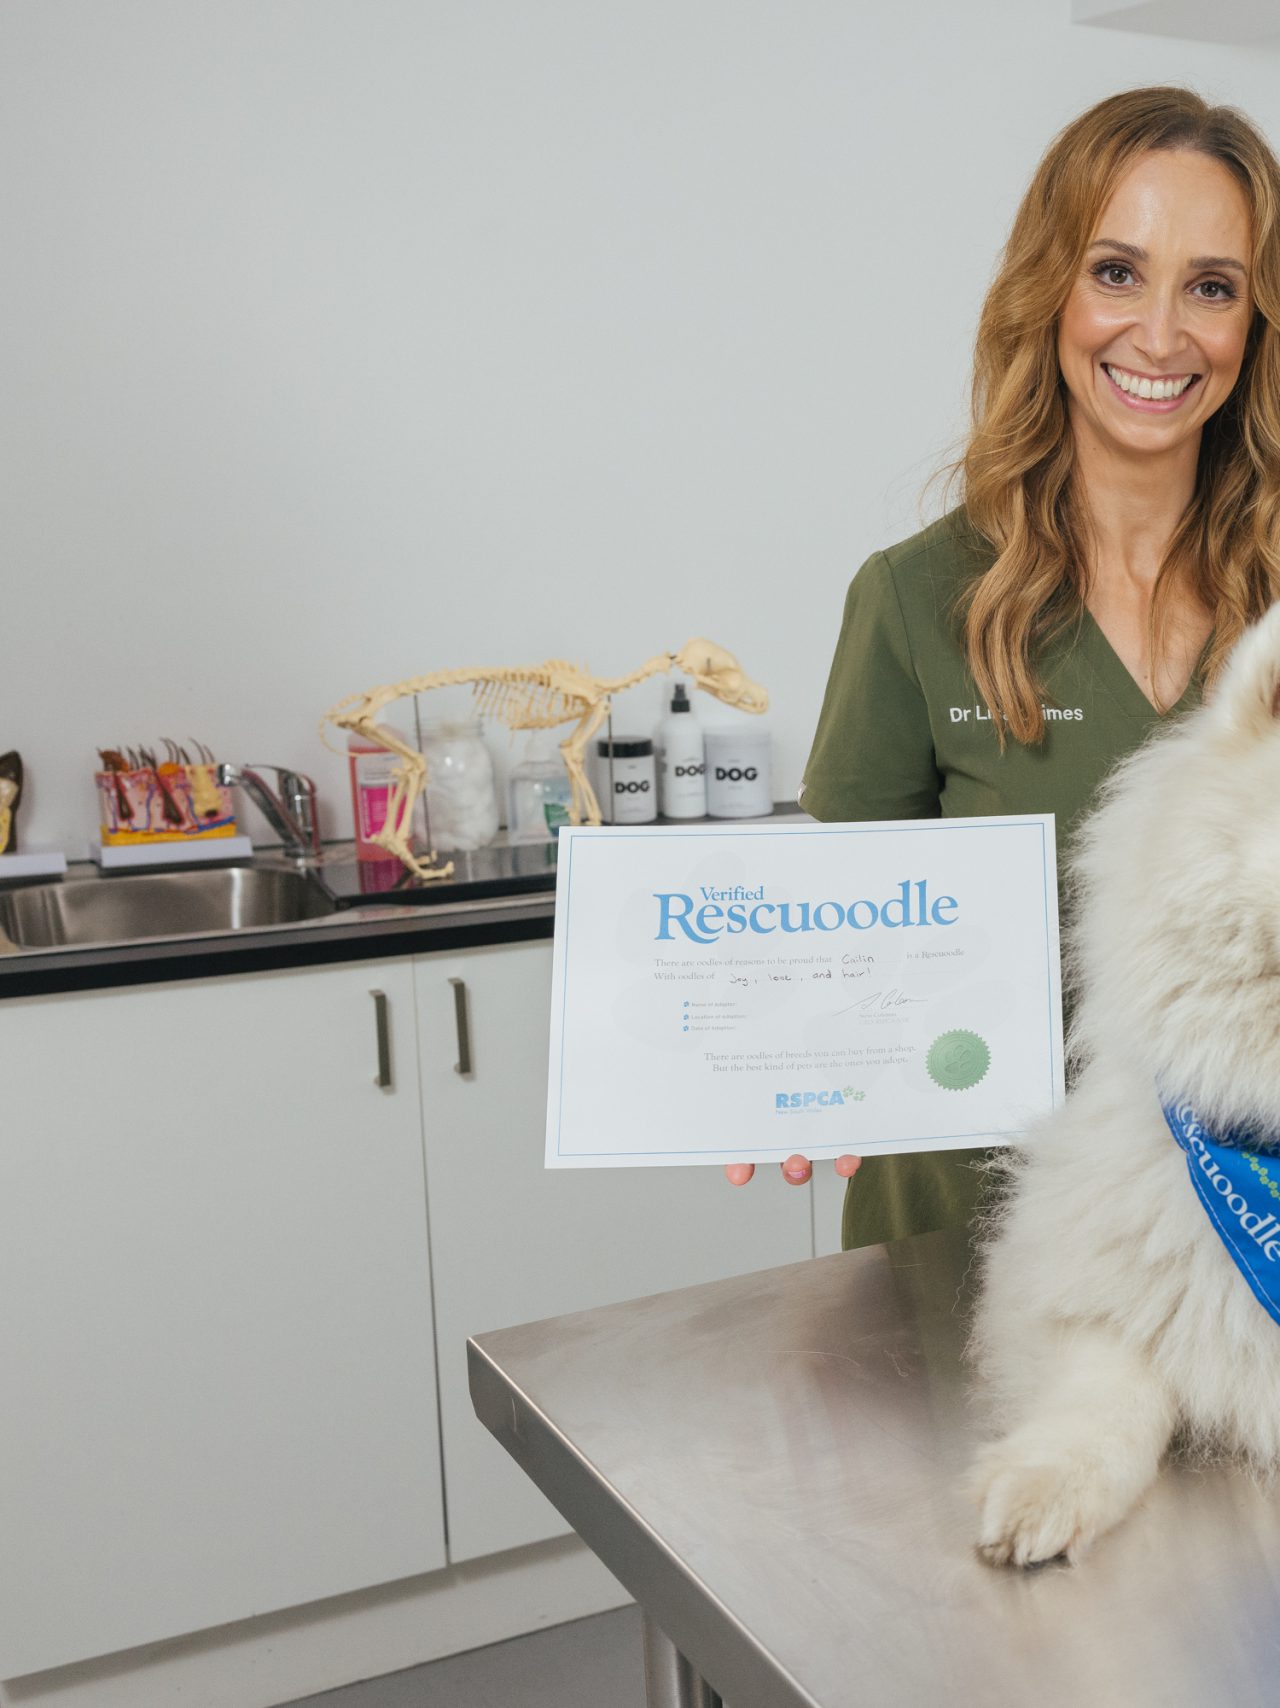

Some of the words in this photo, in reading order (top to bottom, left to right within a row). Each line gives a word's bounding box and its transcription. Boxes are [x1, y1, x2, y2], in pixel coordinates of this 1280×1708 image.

[949, 707, 971, 723] Dr
[714, 767, 758, 781] DOG
[613, 780, 651, 794] DOG
[700, 886, 765, 901] Verified
[653, 879, 960, 944] Rescuoodle
[921, 948, 965, 959] Rescuoodle
[655, 958, 679, 967] There
[697, 957, 722, 966] oodles
[724, 958, 734, 966] of
[735, 959, 765, 967] reasons
[777, 956, 788, 965] be
[789, 955, 814, 966] proud
[816, 955, 832, 963] that
[654, 972, 676, 981] With
[678, 971, 704, 980] oodles
[706, 970, 715, 980] of
[811, 969, 832, 979] and
[704, 1052, 729, 1061] There
[746, 1050, 773, 1060] oodles
[775, 1050, 785, 1059] of
[786, 1049, 812, 1059] breeds
[848, 1047, 864, 1057] buy
[866, 1045, 886, 1055] from
[712, 1063, 729, 1072] But
[730, 1063, 744, 1071] the
[745, 1062, 762, 1071] best
[764, 1061, 784, 1071] kind
[786, 1061, 795, 1070] of
[796, 1062, 813, 1071] pets
[829, 1060, 844, 1068] the
[865, 1059, 881, 1068] you
[775, 1090, 845, 1109] RSPCA
